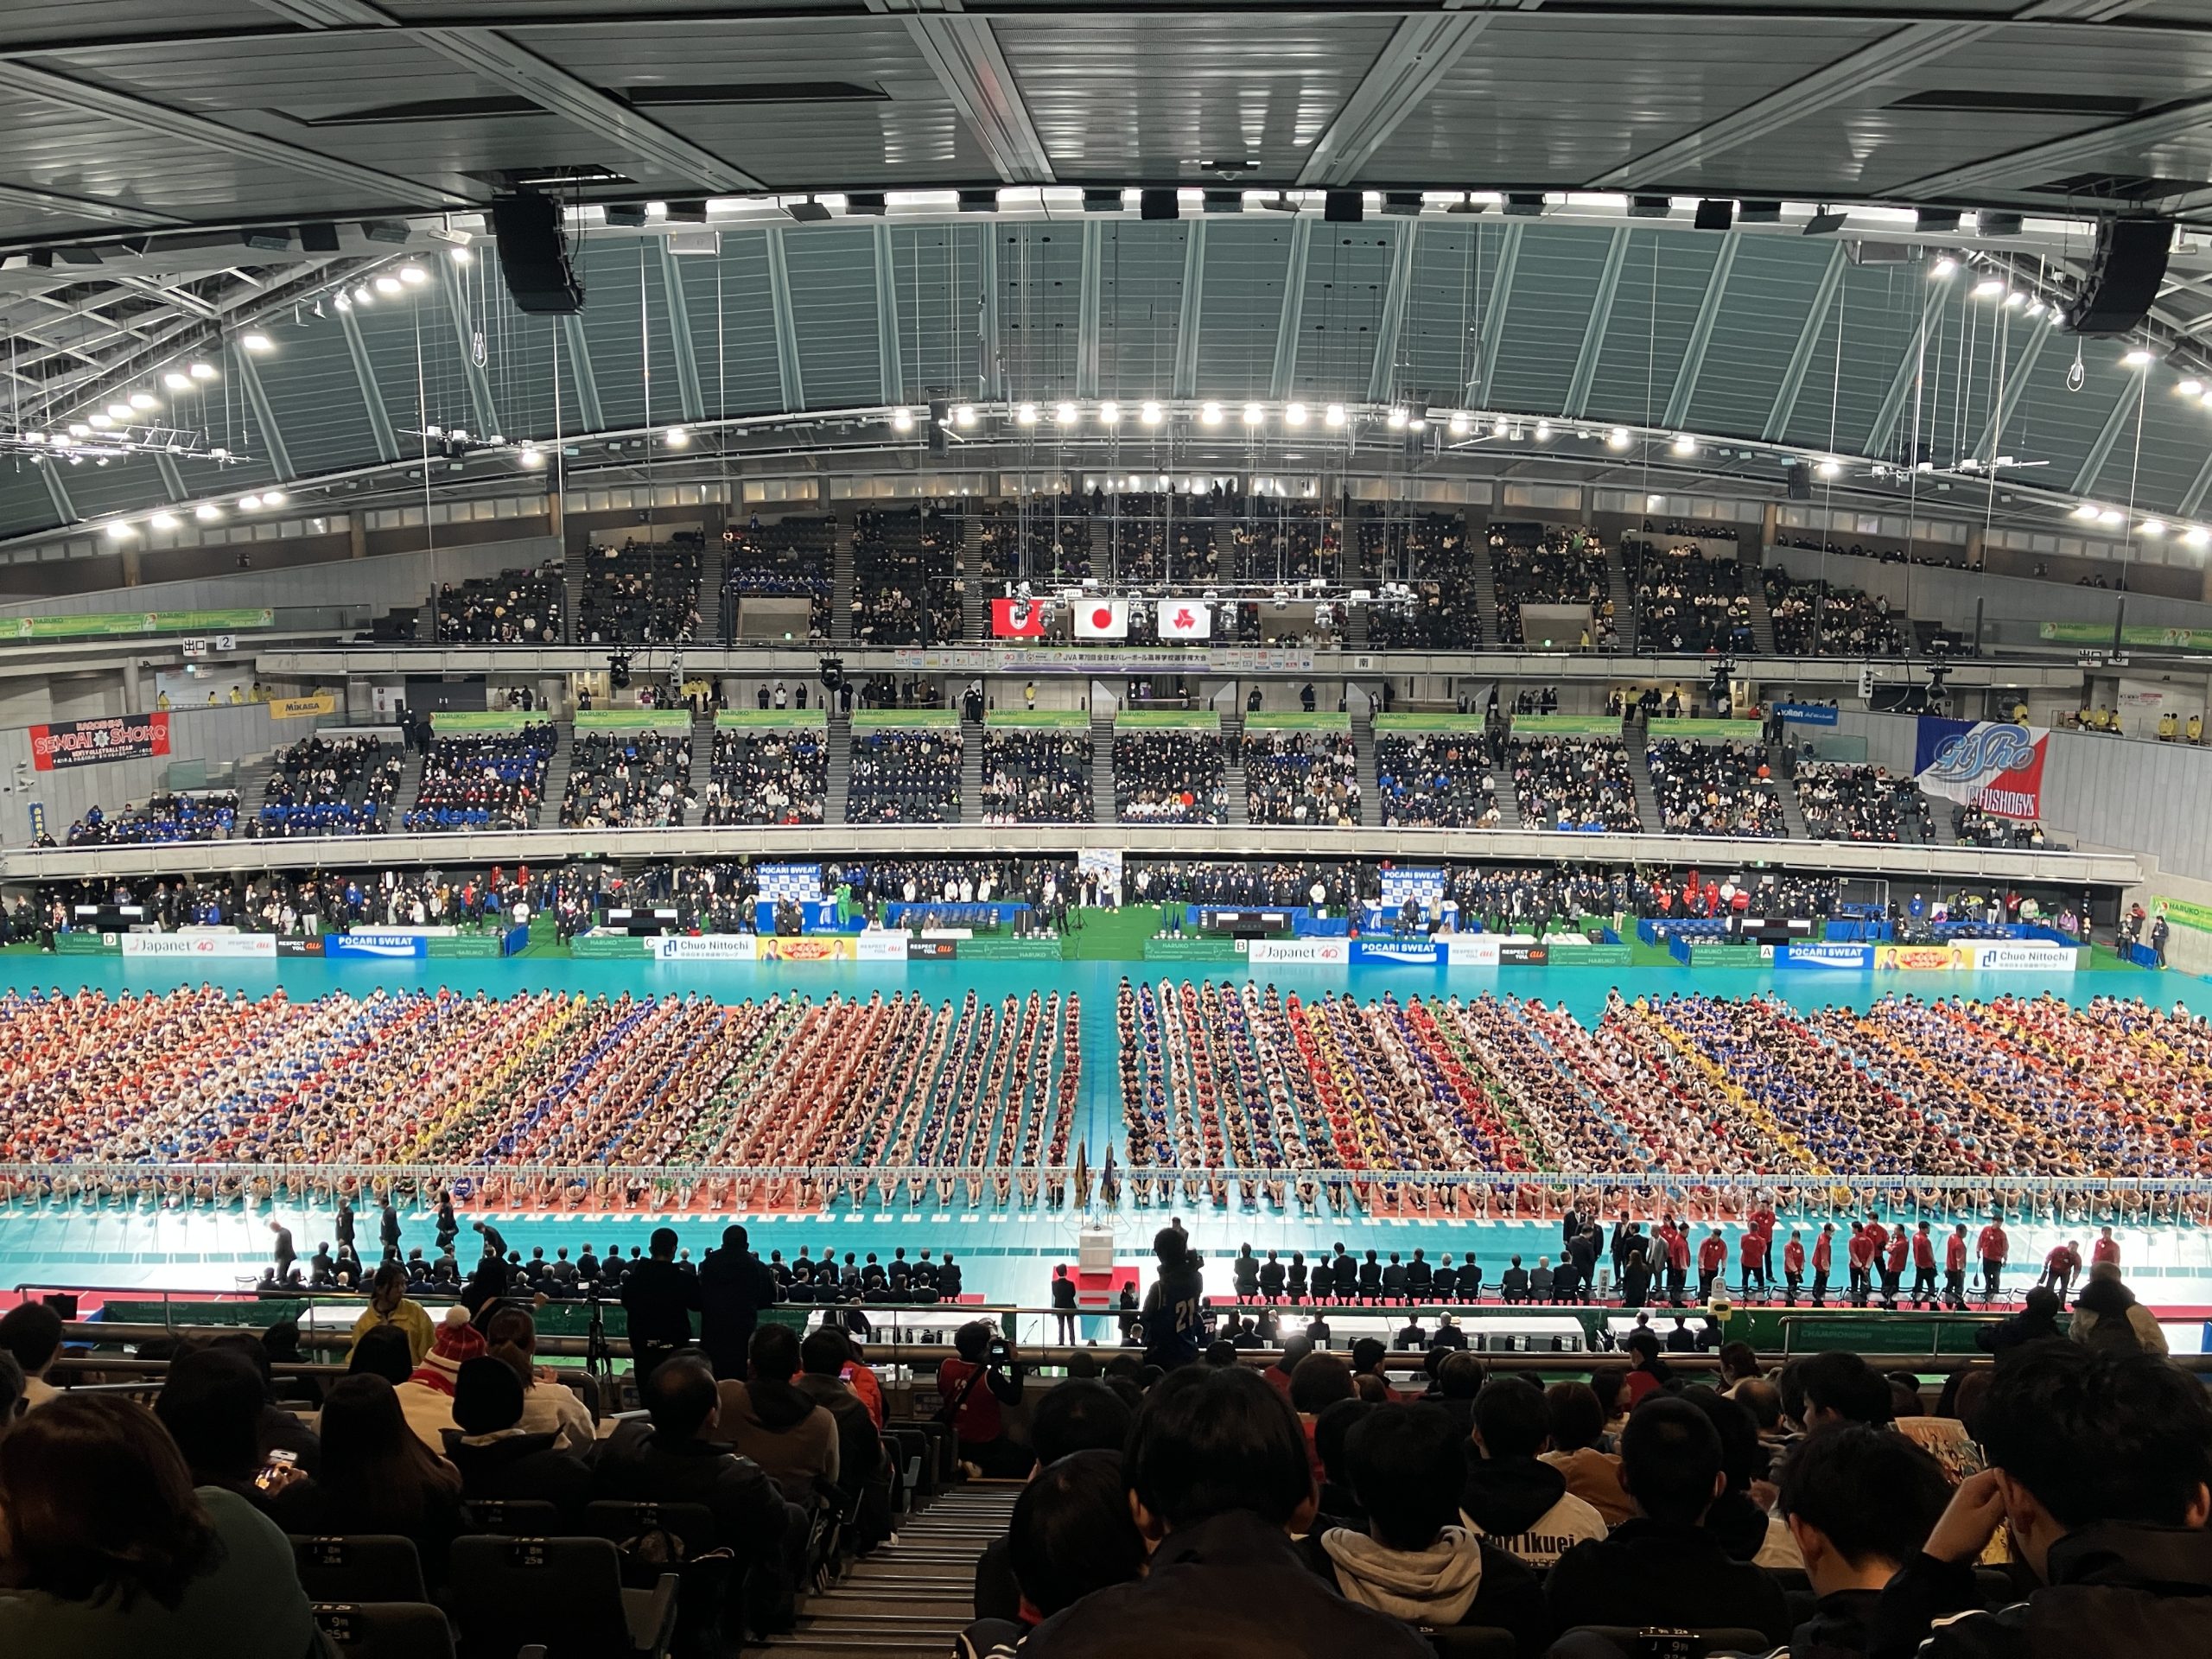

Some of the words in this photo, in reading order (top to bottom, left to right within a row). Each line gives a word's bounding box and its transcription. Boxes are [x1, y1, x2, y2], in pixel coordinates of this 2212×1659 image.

[184, 639, 205, 651] 出口
[34, 732, 92, 754] SENDAI
[110, 724, 167, 745] SHOKO
[2169, 903, 2199, 916] HARUKO
[105, 935, 114, 944] D
[339, 937, 378, 945] POCARI
[378, 937, 413, 945] SWEAT
[141, 940, 190, 954] Japanet
[681, 941, 706, 950] Chuo
[709, 941, 748, 950] Nittochi
[1237, 942, 1245, 950] B
[1362, 944, 1399, 952] POCARI
[1402, 944, 1436, 952] SWEAT
[1266, 946, 1315, 960] Japanet
[1763, 948, 1771, 957] A
[1789, 948, 1827, 957] POCARI
[1828, 948, 1863, 957] SWEAT
[2000, 951, 2025, 961] Chuo
[2028, 951, 2069, 961] Nittochi
[1176, 1297, 1195, 1333] 21
[1204, 1322, 1215, 1334] 78
